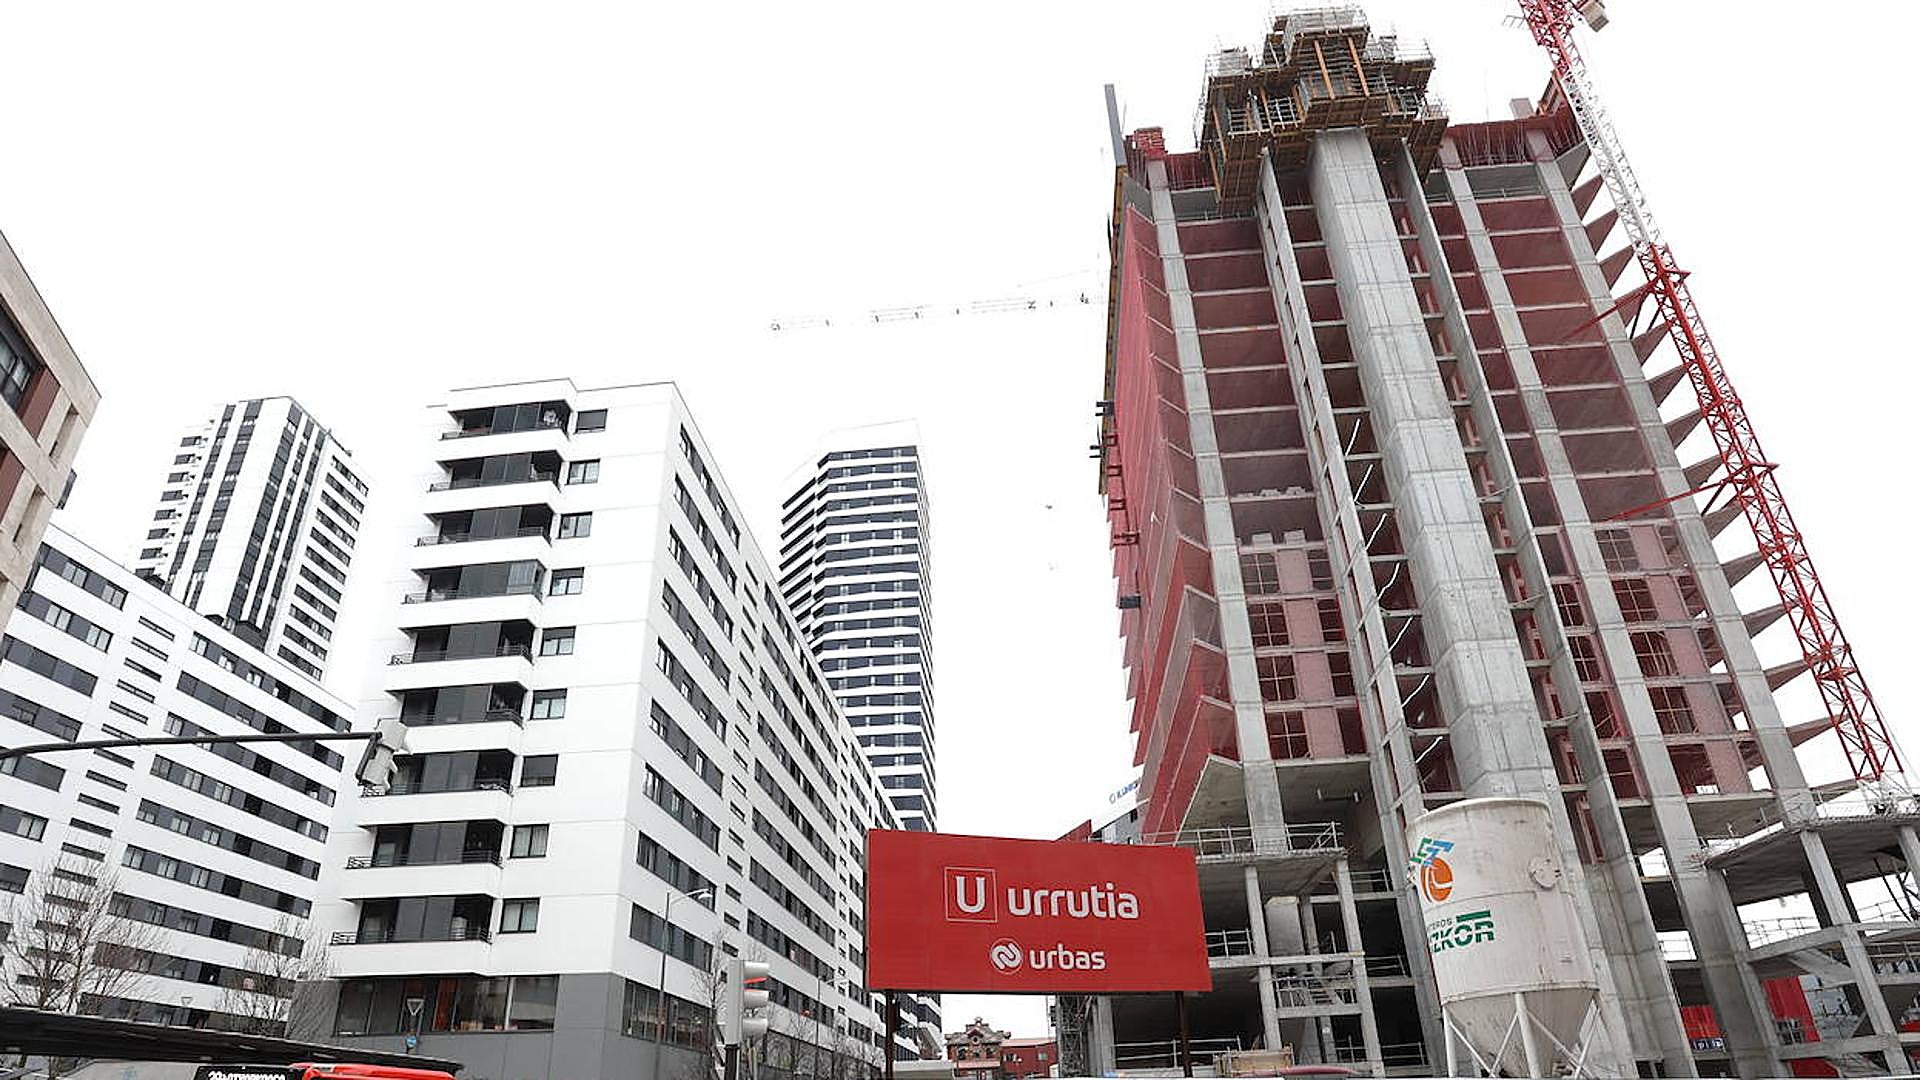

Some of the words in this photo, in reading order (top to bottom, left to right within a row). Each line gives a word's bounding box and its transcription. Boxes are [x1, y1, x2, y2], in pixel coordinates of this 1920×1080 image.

[955, 875, 986, 914] U
[1007, 882, 1139, 920] urrutia
[1029, 943, 1107, 971] urbas
